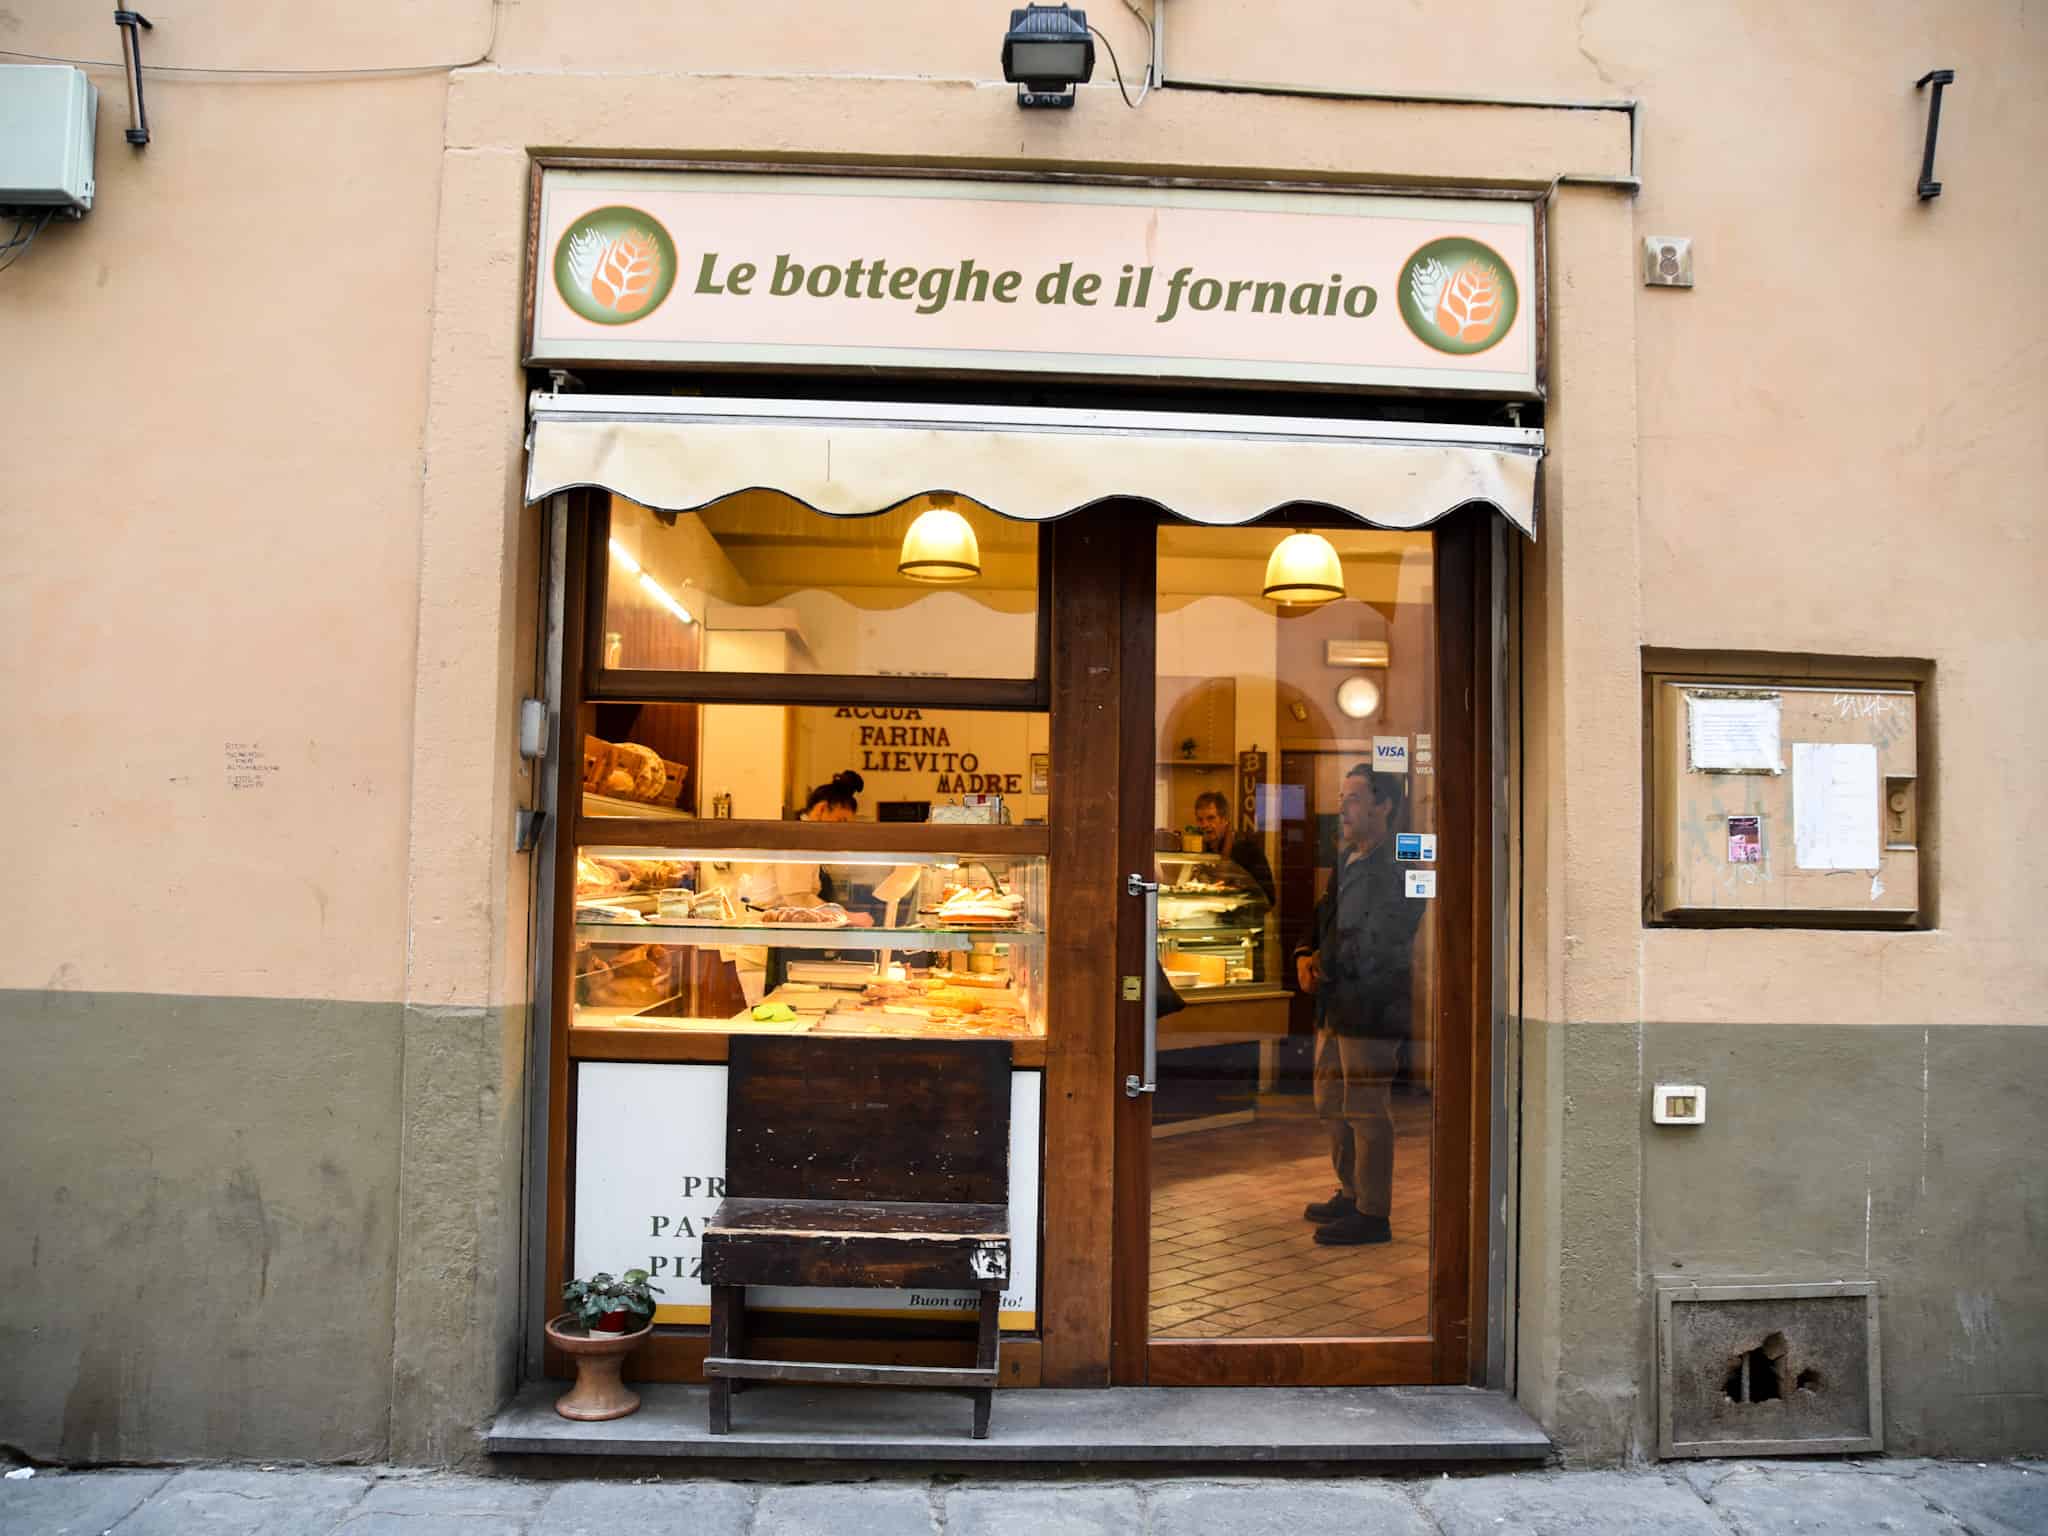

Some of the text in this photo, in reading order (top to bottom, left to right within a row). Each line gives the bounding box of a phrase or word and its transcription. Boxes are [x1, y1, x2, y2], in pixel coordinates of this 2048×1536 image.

[694, 252, 1378, 323] Le botteghe de il fornaio
[860, 726, 950, 746] FARINA
[862, 750, 978, 772] LIEVITO
[1377, 745, 1405, 757] VISA
[936, 774, 1022, 794] MADRE
[909, 1294, 949, 1306] Buon
